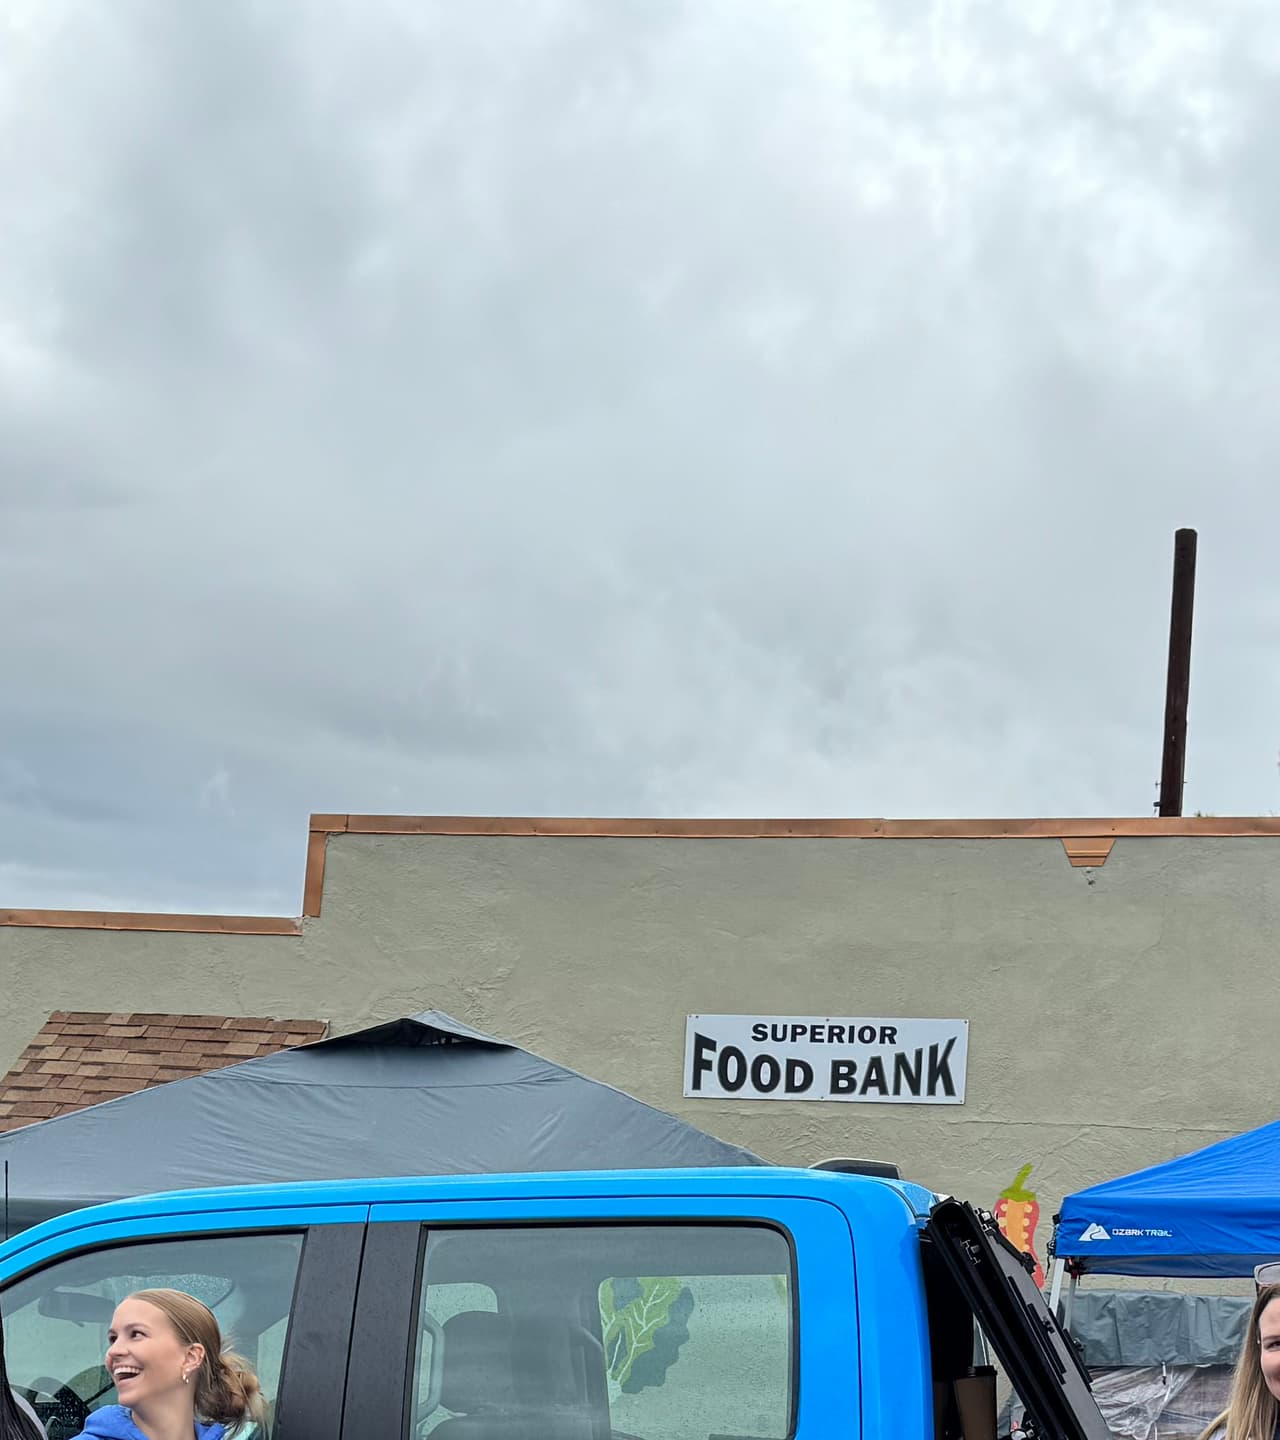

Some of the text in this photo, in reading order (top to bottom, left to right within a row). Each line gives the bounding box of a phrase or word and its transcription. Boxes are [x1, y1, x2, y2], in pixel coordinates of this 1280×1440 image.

[751, 1023, 898, 1045] SUPERIOR
[691, 1032, 957, 1097] FOOD BANK
[1145, 1229, 1172, 1237] TRAIL
